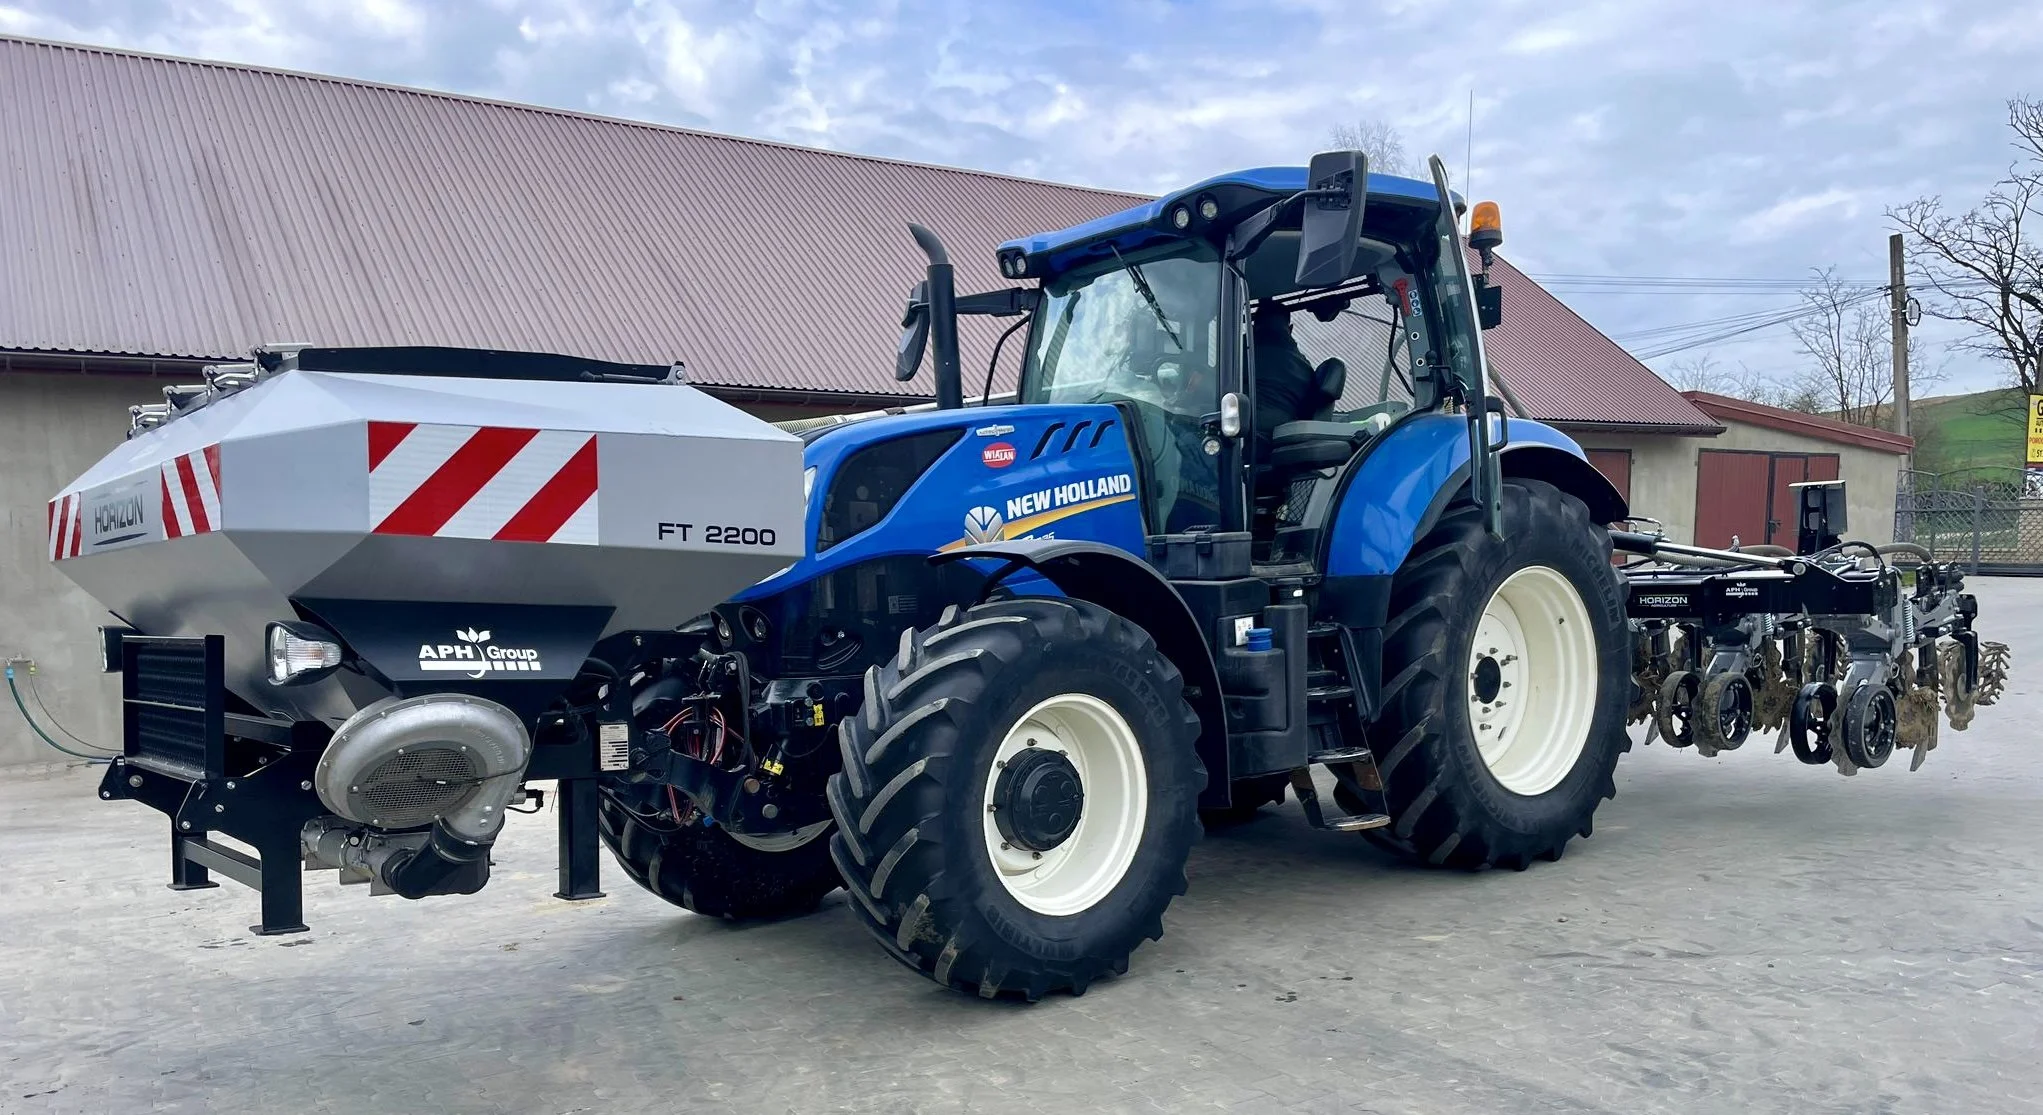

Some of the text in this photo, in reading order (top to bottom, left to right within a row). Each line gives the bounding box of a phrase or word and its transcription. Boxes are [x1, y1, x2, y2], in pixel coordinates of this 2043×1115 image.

[1007, 474, 1131, 520] NEW HOLLAND
[94, 494, 144, 535] HORIZON
[658, 522, 776, 546] FT 2200
[1639, 596, 1688, 604] HORIZON
[419, 644, 538, 661] APH Group
